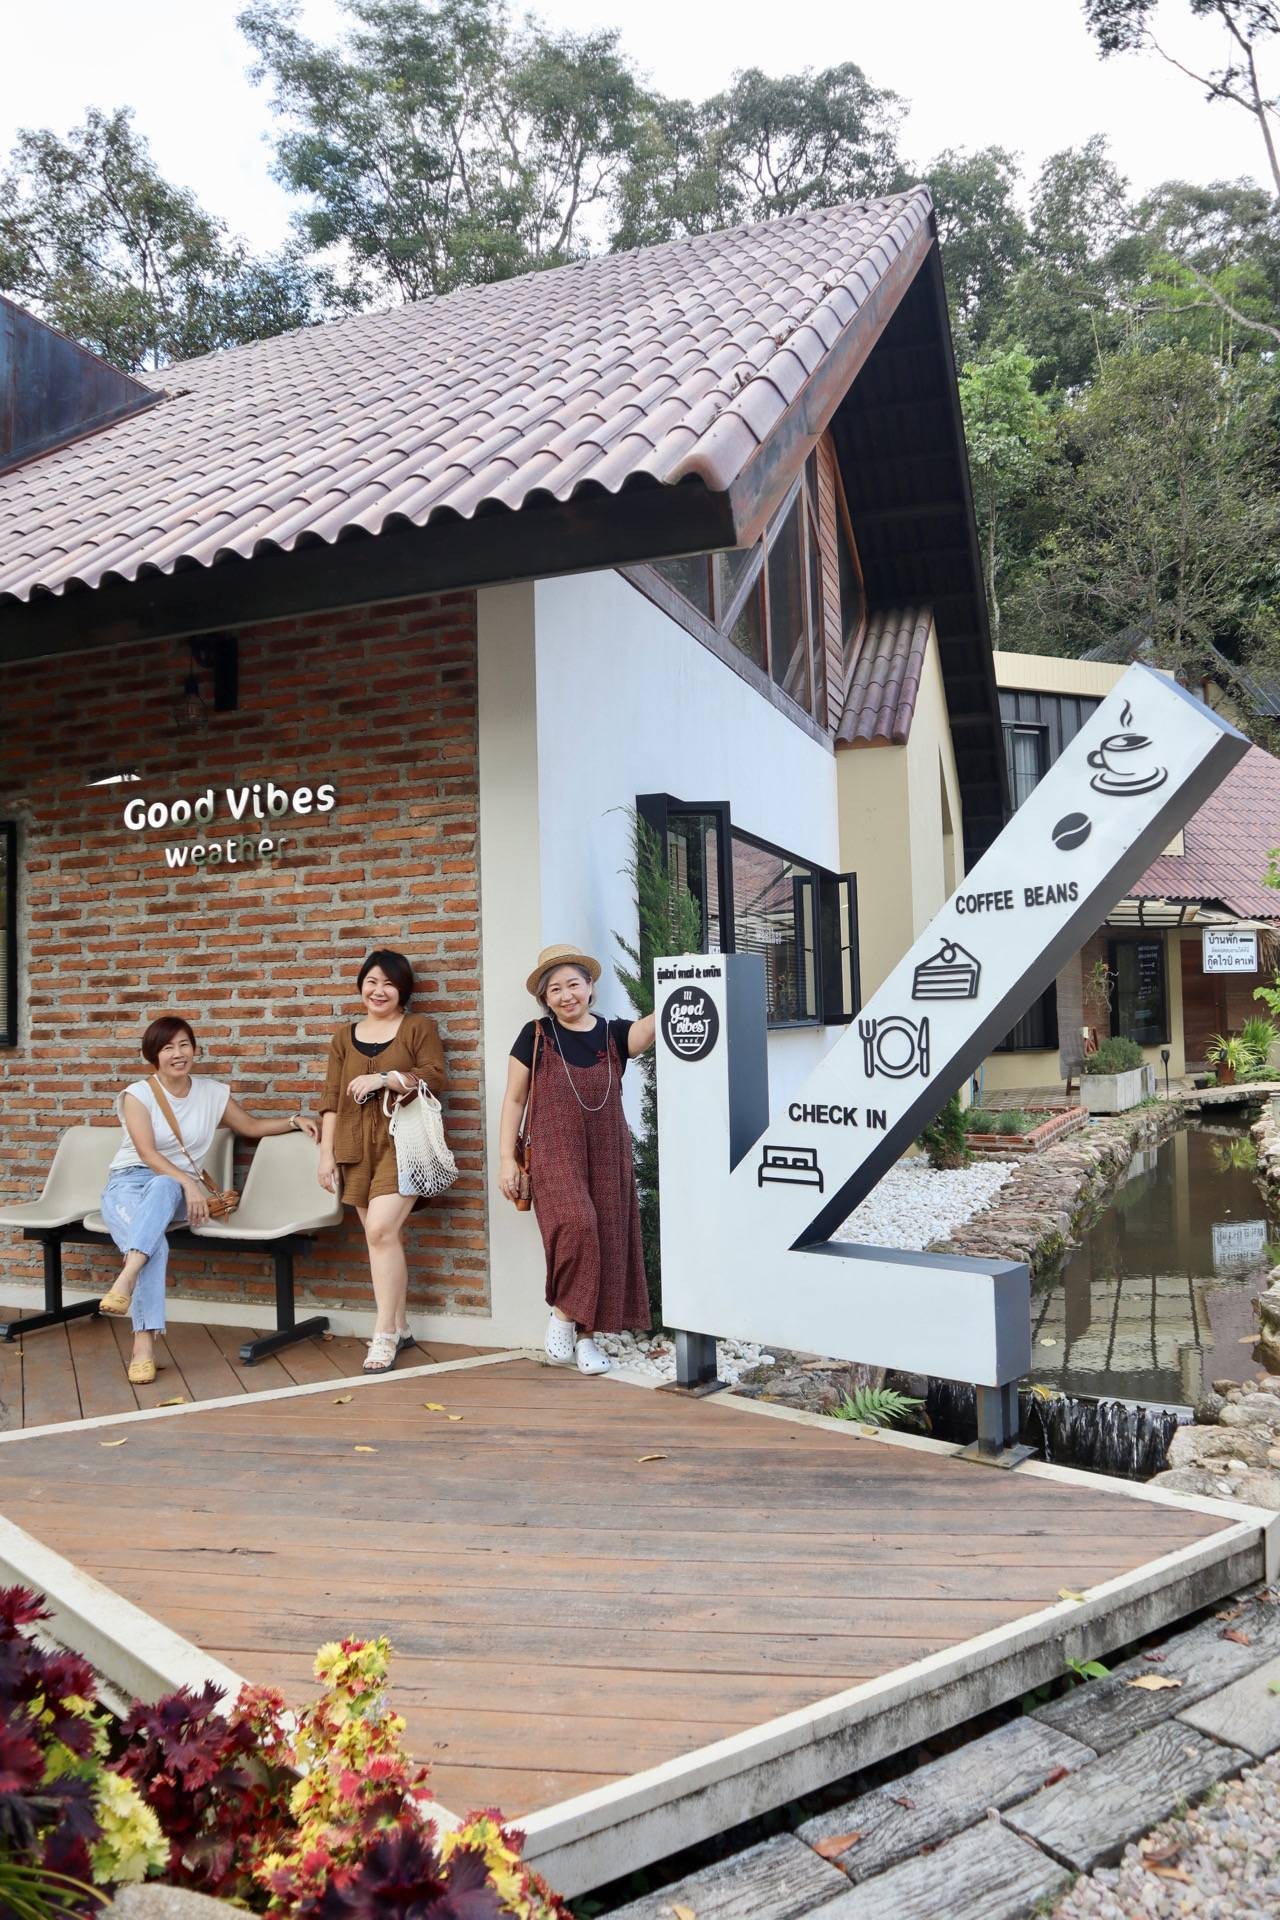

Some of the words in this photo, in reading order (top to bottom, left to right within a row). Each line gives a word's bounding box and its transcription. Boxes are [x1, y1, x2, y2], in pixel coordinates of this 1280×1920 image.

[124, 789, 214, 831] Good
[225, 782, 336, 820] Vibes
[165, 837, 289, 868] weather
[955, 889, 1014, 914] COFFEE
[1024, 881, 1079, 907] BEANS
[788, 1102, 858, 1127] CHECK
[866, 1108, 887, 1130] IN
